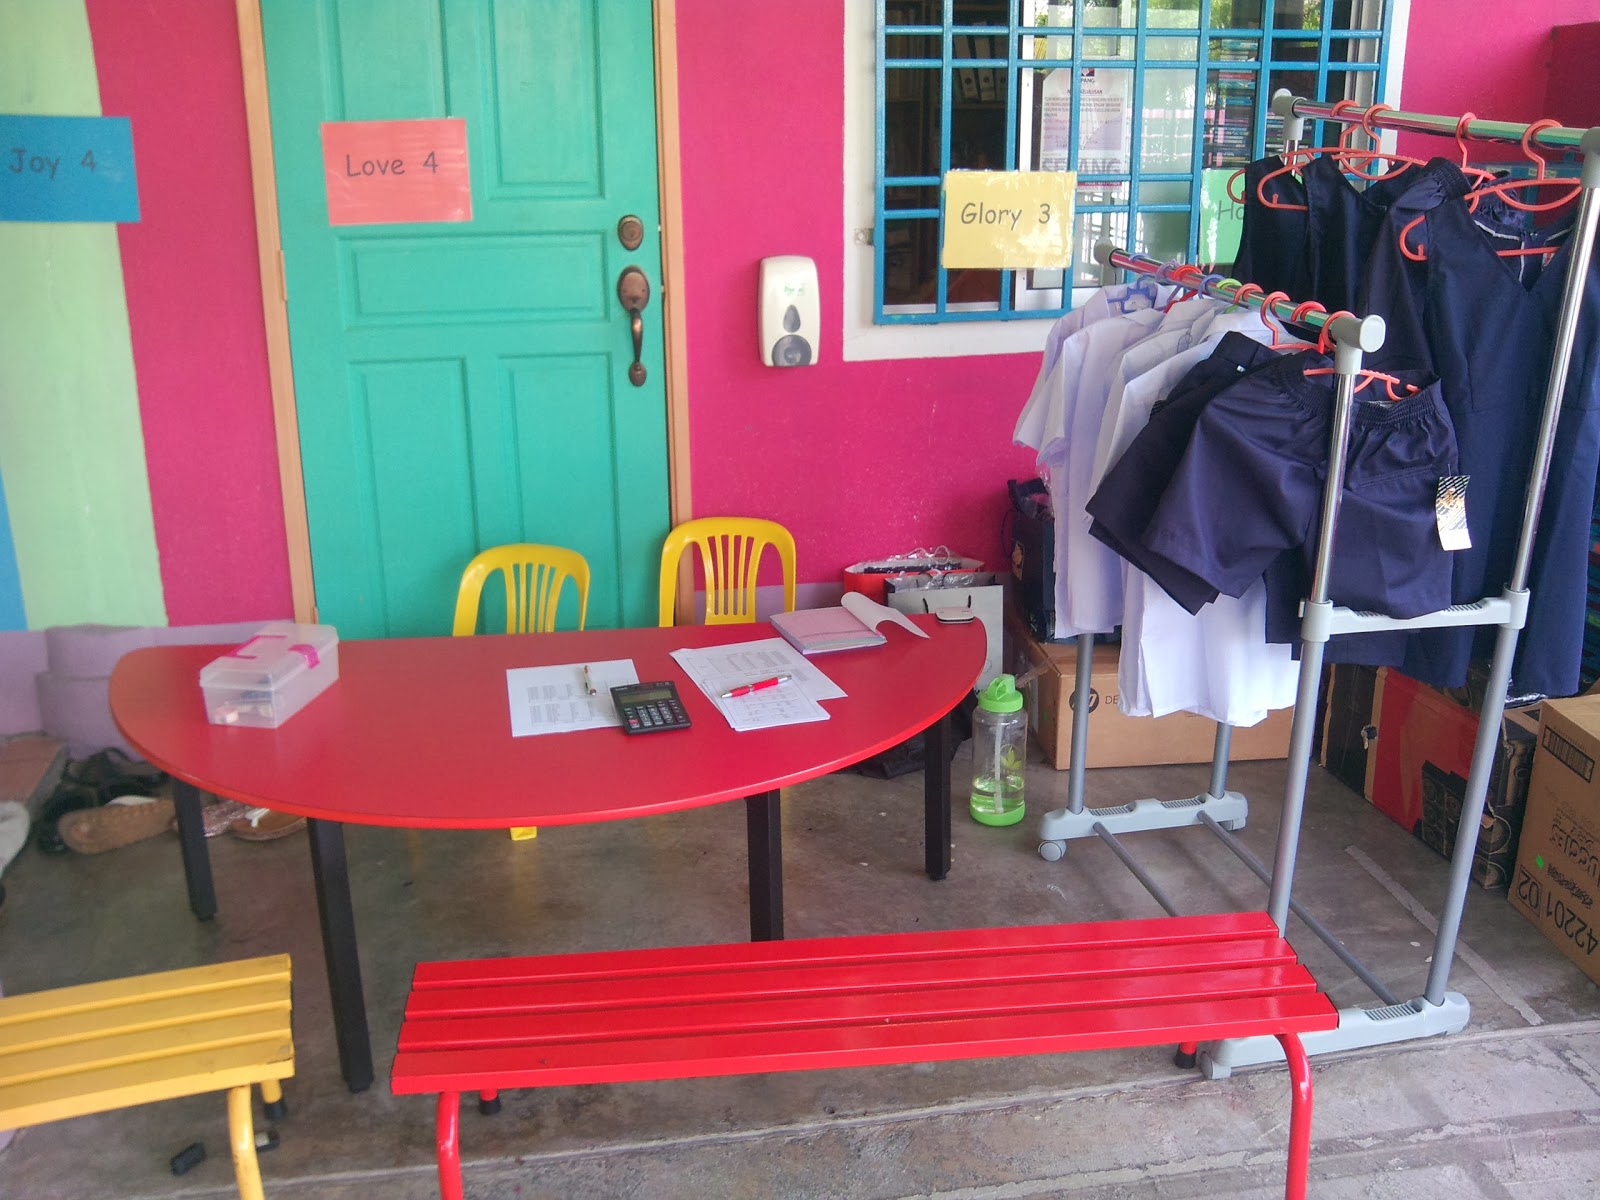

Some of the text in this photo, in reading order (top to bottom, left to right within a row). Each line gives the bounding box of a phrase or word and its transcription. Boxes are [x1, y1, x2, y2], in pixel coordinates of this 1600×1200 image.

[8, 147, 97, 182] Joy 4
[345, 151, 439, 177] Love 4
[1041, 157, 1121, 175] SEANG
[960, 201, 1051, 231] Glory 3
[1217, 199, 1245, 221] Ho
[1105, 694, 1120, 705] DE
[1518, 869, 1540, 910] 02
[1545, 890, 1599, 956] 42201
